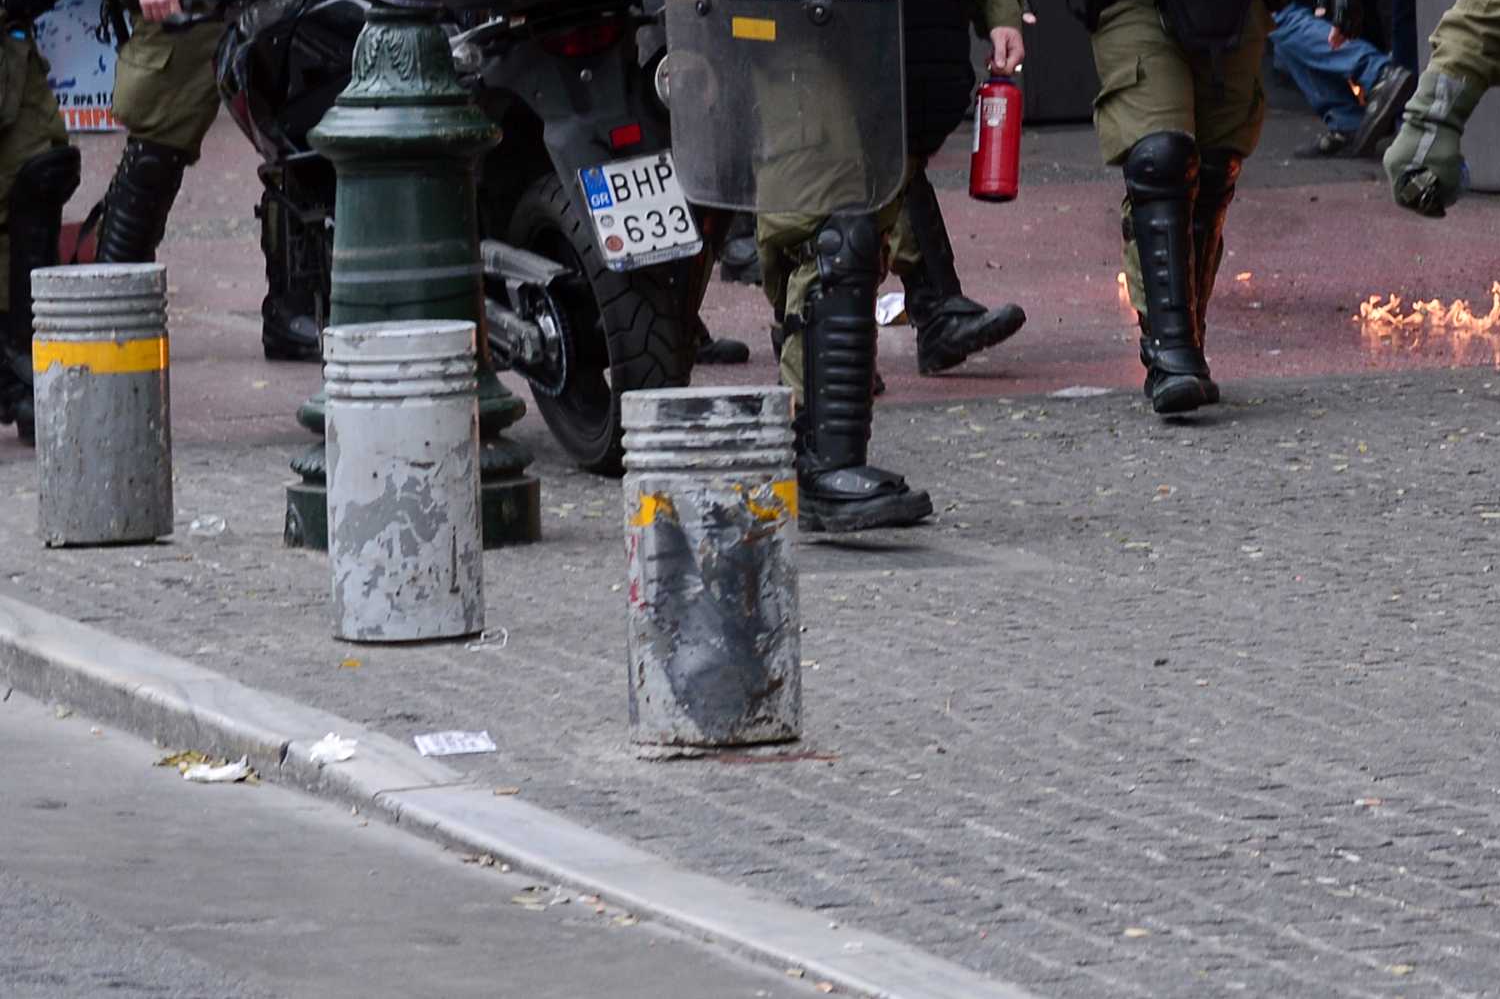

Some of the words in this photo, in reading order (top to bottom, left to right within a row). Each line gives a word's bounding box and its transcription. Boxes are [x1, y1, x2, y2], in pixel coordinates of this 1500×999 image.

[590, 192, 611, 208] GR
[610, 163, 673, 203] BHP
[623, 205, 690, 243] 633
